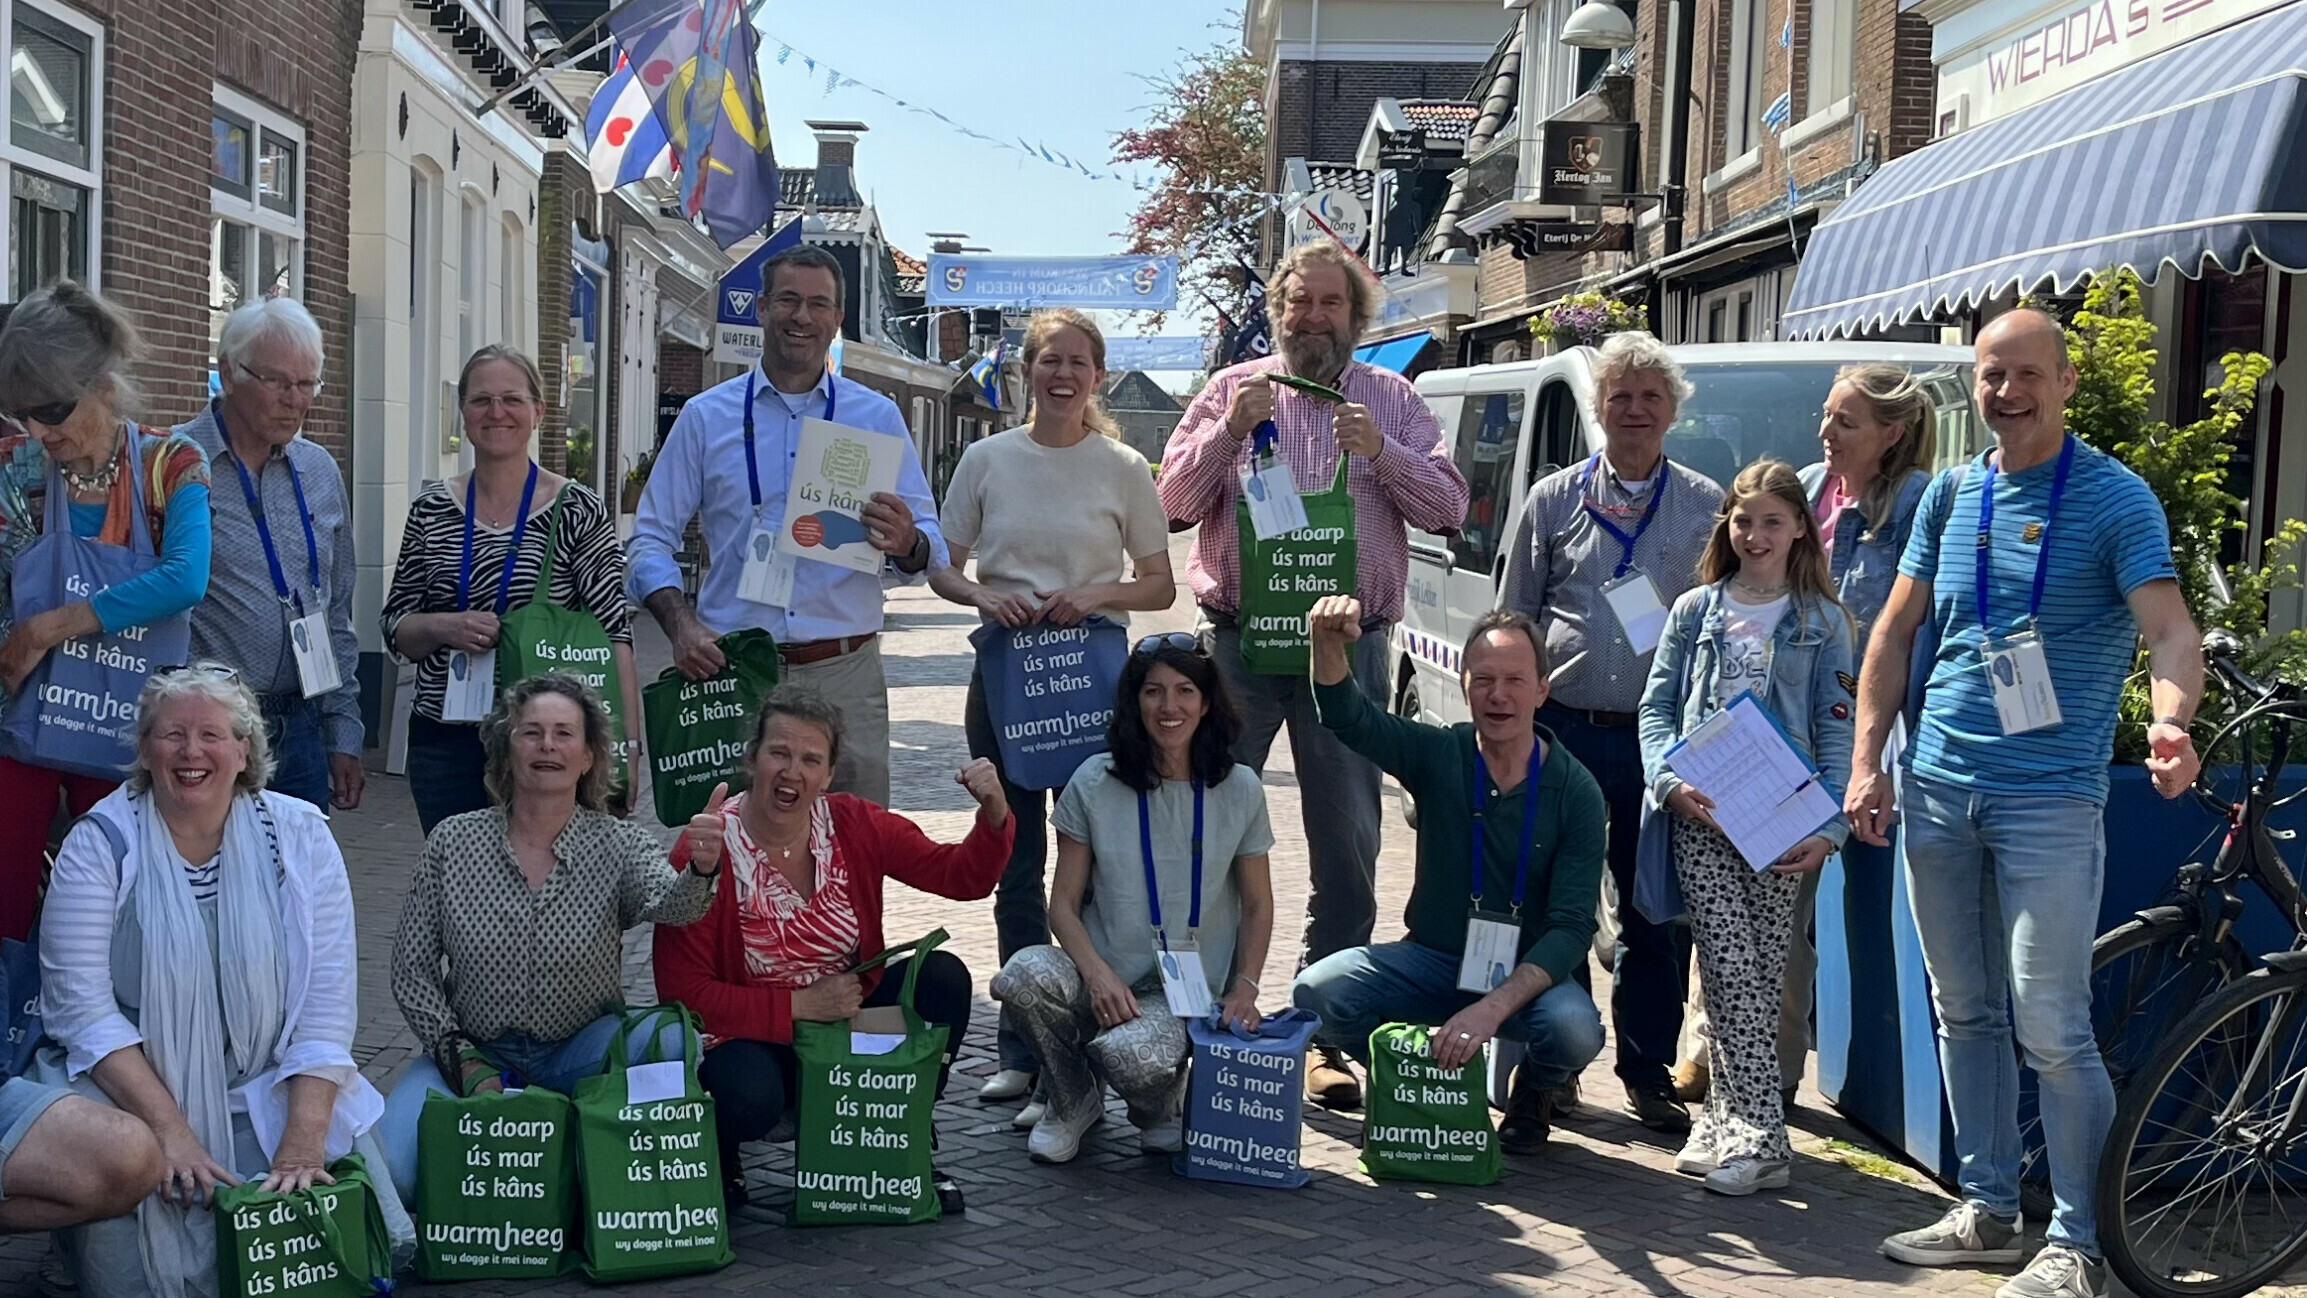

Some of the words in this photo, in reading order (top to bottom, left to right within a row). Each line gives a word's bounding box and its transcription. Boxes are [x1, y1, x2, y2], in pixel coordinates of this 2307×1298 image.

[1554, 170, 1590, 184] Hertog
[1592, 171, 1612, 183] Jan
[722, 331, 763, 348] WATERL
[800, 482, 822, 503] ús
[828, 487, 864, 511] kân
[1272, 548, 1293, 567] ús
[1299, 552, 1336, 567] mar
[66, 574, 90, 597] ús
[1268, 573, 1289, 592] ús
[1295, 574, 1338, 592] kâns
[535, 639, 557, 660] ús
[561, 643, 611, 665] doarp
[1013, 631, 1033, 650] ús
[63, 636, 88, 660] ús
[95, 642, 147, 674] kâns
[1024, 653, 1044, 673] ús
[1049, 651, 1085, 669] mar
[679, 681, 698, 701] ús
[703, 678, 738, 695] mar
[1024, 677, 1045, 698] ús
[1050, 674, 1092, 694] kâns
[53, 714, 85, 731] dogge
[87, 721, 95, 733] it
[97, 726, 116, 737] mei
[679, 707, 698, 728] ús
[703, 701, 744, 722] kâns
[1035, 739, 1060, 751] dogge
[687, 772, 711, 783] dogge
[1237, 1048, 1295, 1076] doarp
[1397, 1059, 1419, 1078] ús
[829, 1064, 851, 1087] ús
[858, 1068, 917, 1095] doarp
[1216, 1067, 1238, 1088] ús
[1244, 1076, 1285, 1096] mar
[1394, 1083, 1416, 1104] ús
[1422, 1085, 1468, 1105] kâns
[618, 1105, 643, 1121] ús
[649, 1102, 705, 1122] doarp
[835, 1094, 858, 1116] ús
[865, 1102, 908, 1119] mar
[1211, 1092, 1233, 1113] ús
[1239, 1097, 1284, 1122] kâns
[458, 1112, 483, 1135] ús
[489, 1117, 555, 1142] doarp
[830, 1123, 853, 1145] ús
[860, 1126, 909, 1149] kâns
[629, 1129, 654, 1152] ús
[660, 1131, 702, 1150] mar
[466, 1144, 491, 1166] ús
[498, 1151, 543, 1168] mar
[1206, 1156, 1234, 1171] dogge
[1380, 1150, 1394, 1159] wy
[1395, 1150, 1422, 1161] dogge
[1424, 1150, 1431, 1160] it
[1433, 1151, 1450, 1162] mei
[1451, 1152, 1474, 1162] inoar
[627, 1159, 652, 1181] ús
[659, 1157, 708, 1181] kâns
[461, 1174, 486, 1197] ús
[493, 1175, 545, 1198] kâns
[797, 1170, 921, 1200] warmheeg
[233, 1206, 261, 1231] ús
[812, 1200, 827, 1212] wy
[829, 1200, 858, 1213] dogge
[859, 1201, 867, 1211] it
[869, 1203, 886, 1213] mei
[888, 1204, 911, 1215] inoar
[248, 1237, 276, 1262] ús
[283, 1231, 326, 1256] ma
[426, 1221, 564, 1252] warmheeg
[615, 1241, 631, 1251] wy
[632, 1238, 663, 1251] dogge
[665, 1237, 673, 1248] it
[675, 1236, 693, 1247] mei
[694, 1235, 716, 1246] inoa
[441, 1254, 457, 1265] wy
[459, 1252, 490, 1266] dogge
[492, 1253, 500, 1264] it
[502, 1254, 520, 1264] mei
[522, 1254, 548, 1266] inoar
[248, 1271, 275, 1296] ús
[283, 1261, 339, 1289] kâns
